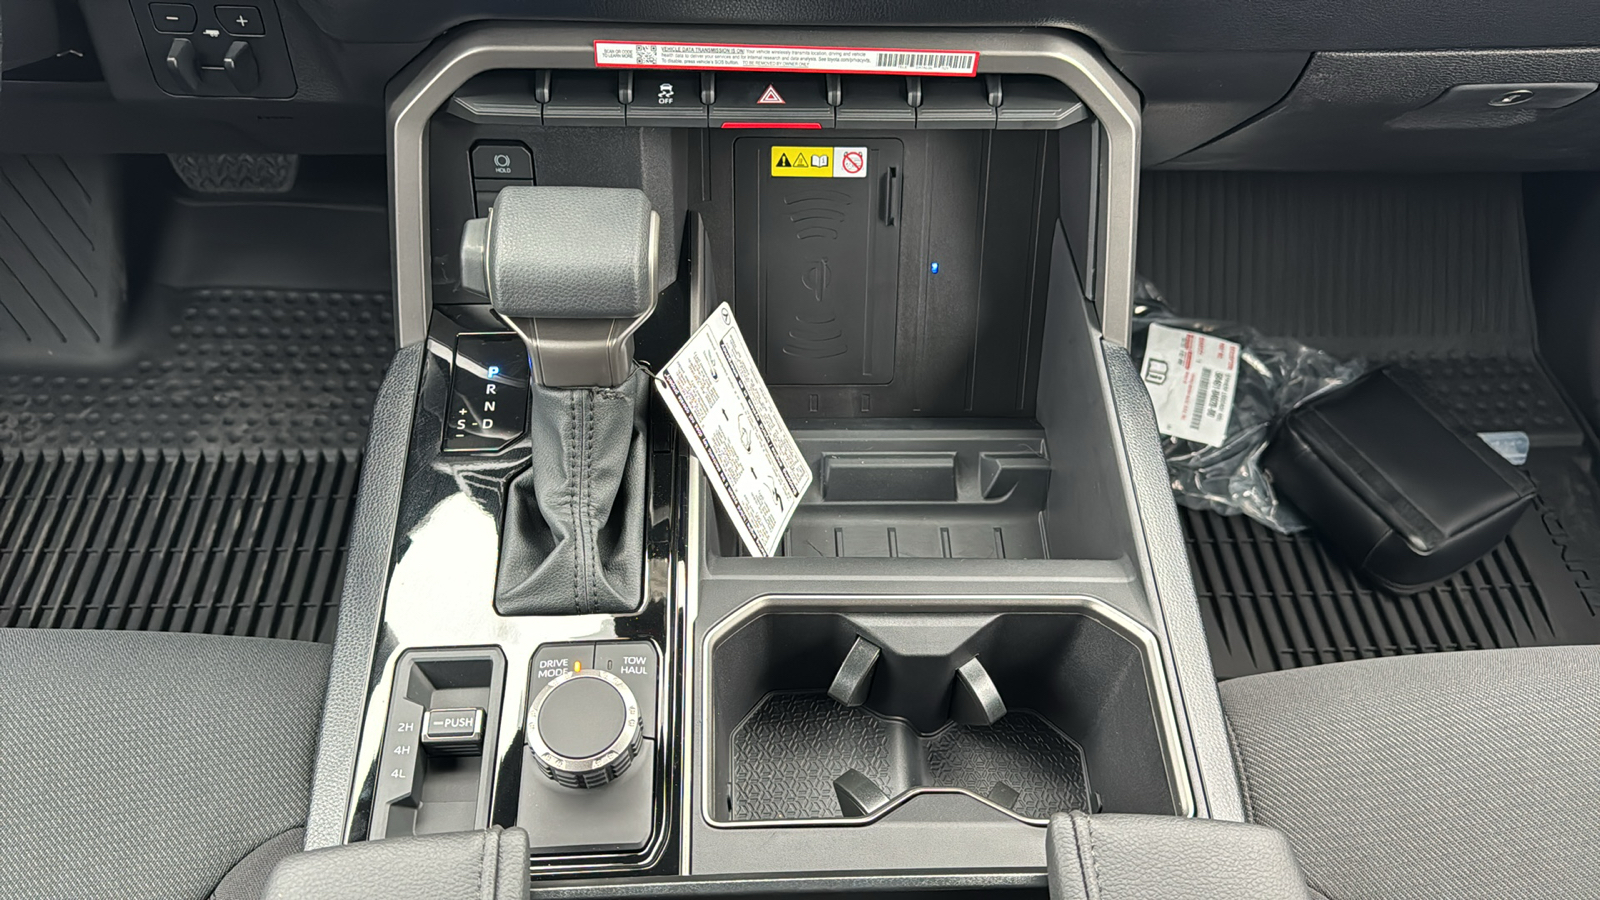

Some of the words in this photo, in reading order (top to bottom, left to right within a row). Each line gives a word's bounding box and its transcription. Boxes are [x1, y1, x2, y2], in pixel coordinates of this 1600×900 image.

[488, 366, 499, 378] P
[486, 384, 496, 394] R
[484, 401, 495, 411] N
[457, 420, 466, 429] S
[482, 419, 493, 428] D
[540, 659, 568, 668] DRIVE
[623, 656, 646, 664] TOW
[538, 668, 568, 678] MODE
[621, 666, 648, 674] HAUL
[444, 718, 473, 727] PUSH
[398, 723, 414, 732] 2H
[394, 746, 410, 754] 4H
[391, 769, 406, 778] 4L
